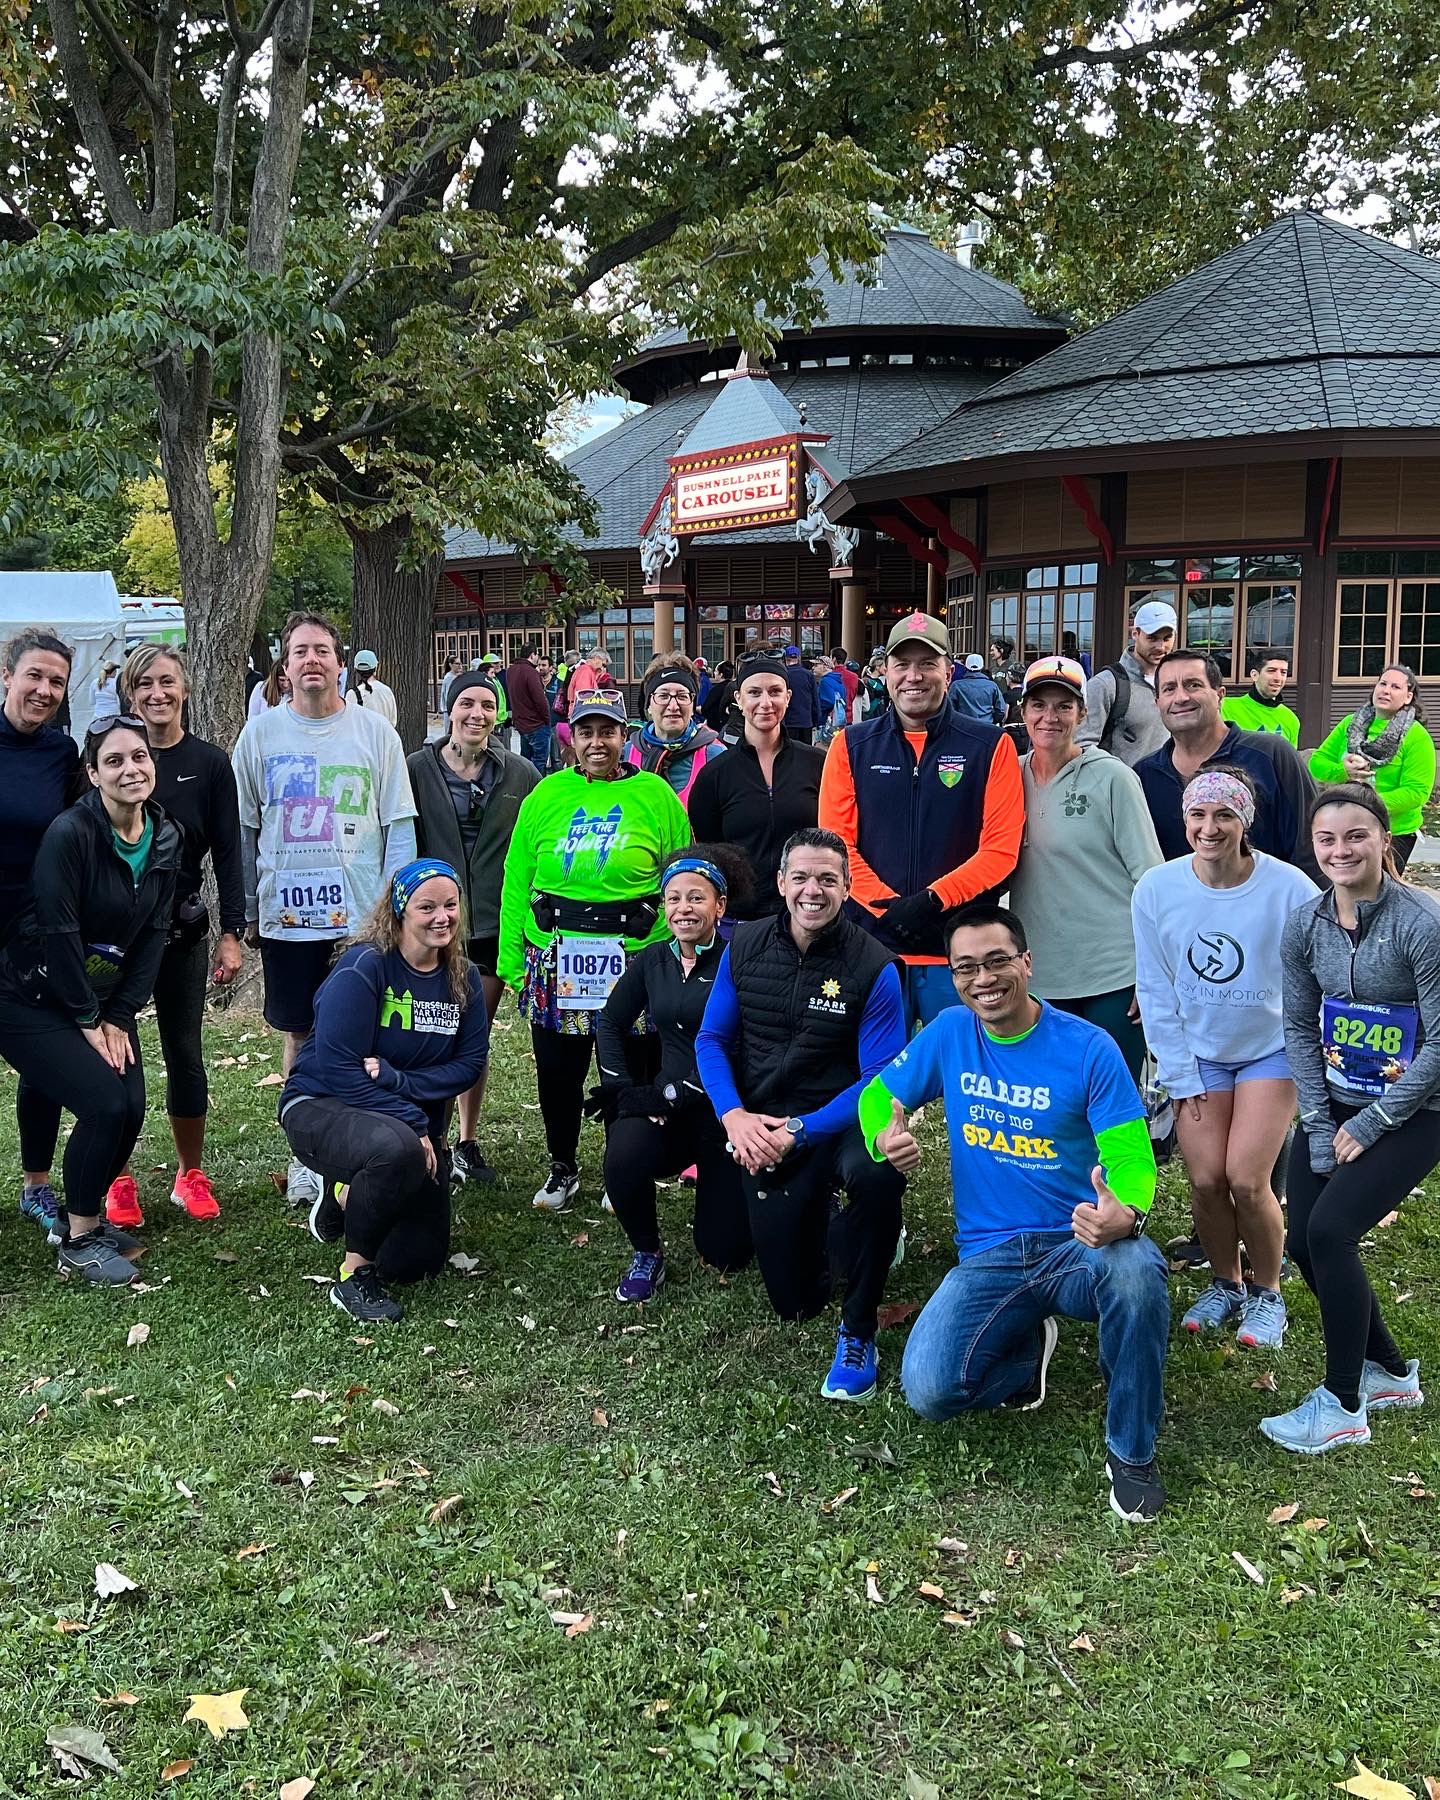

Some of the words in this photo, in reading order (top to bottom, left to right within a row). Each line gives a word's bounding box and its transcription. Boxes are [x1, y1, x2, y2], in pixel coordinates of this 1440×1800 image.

[683, 476, 745, 493] BUSHNELL
[747, 469, 782, 482] PARK
[681, 483, 783, 510] CAROUSEL
[571, 824, 593, 835] FEEL
[596, 823, 615, 833] THE
[553, 833, 631, 855] POWER!
[280, 884, 342, 908] 10148
[561, 953, 622, 976] 10876
[809, 997, 847, 1011] SPARK
[1200, 986, 1214, 998] IN
[1219, 986, 1273, 1001] MOTION
[413, 1008, 460, 1020] HARTFORD
[1349, 1002, 1391, 1015] EVERSOURCE
[414, 1015, 460, 1028] MARATHON
[1332, 1016, 1403, 1055] 3248
[960, 1072, 1051, 1110] CARBS
[969, 1104, 1005, 1124] give
[1009, 1114, 1033, 1131] me
[962, 1123, 1058, 1159] SPARK
